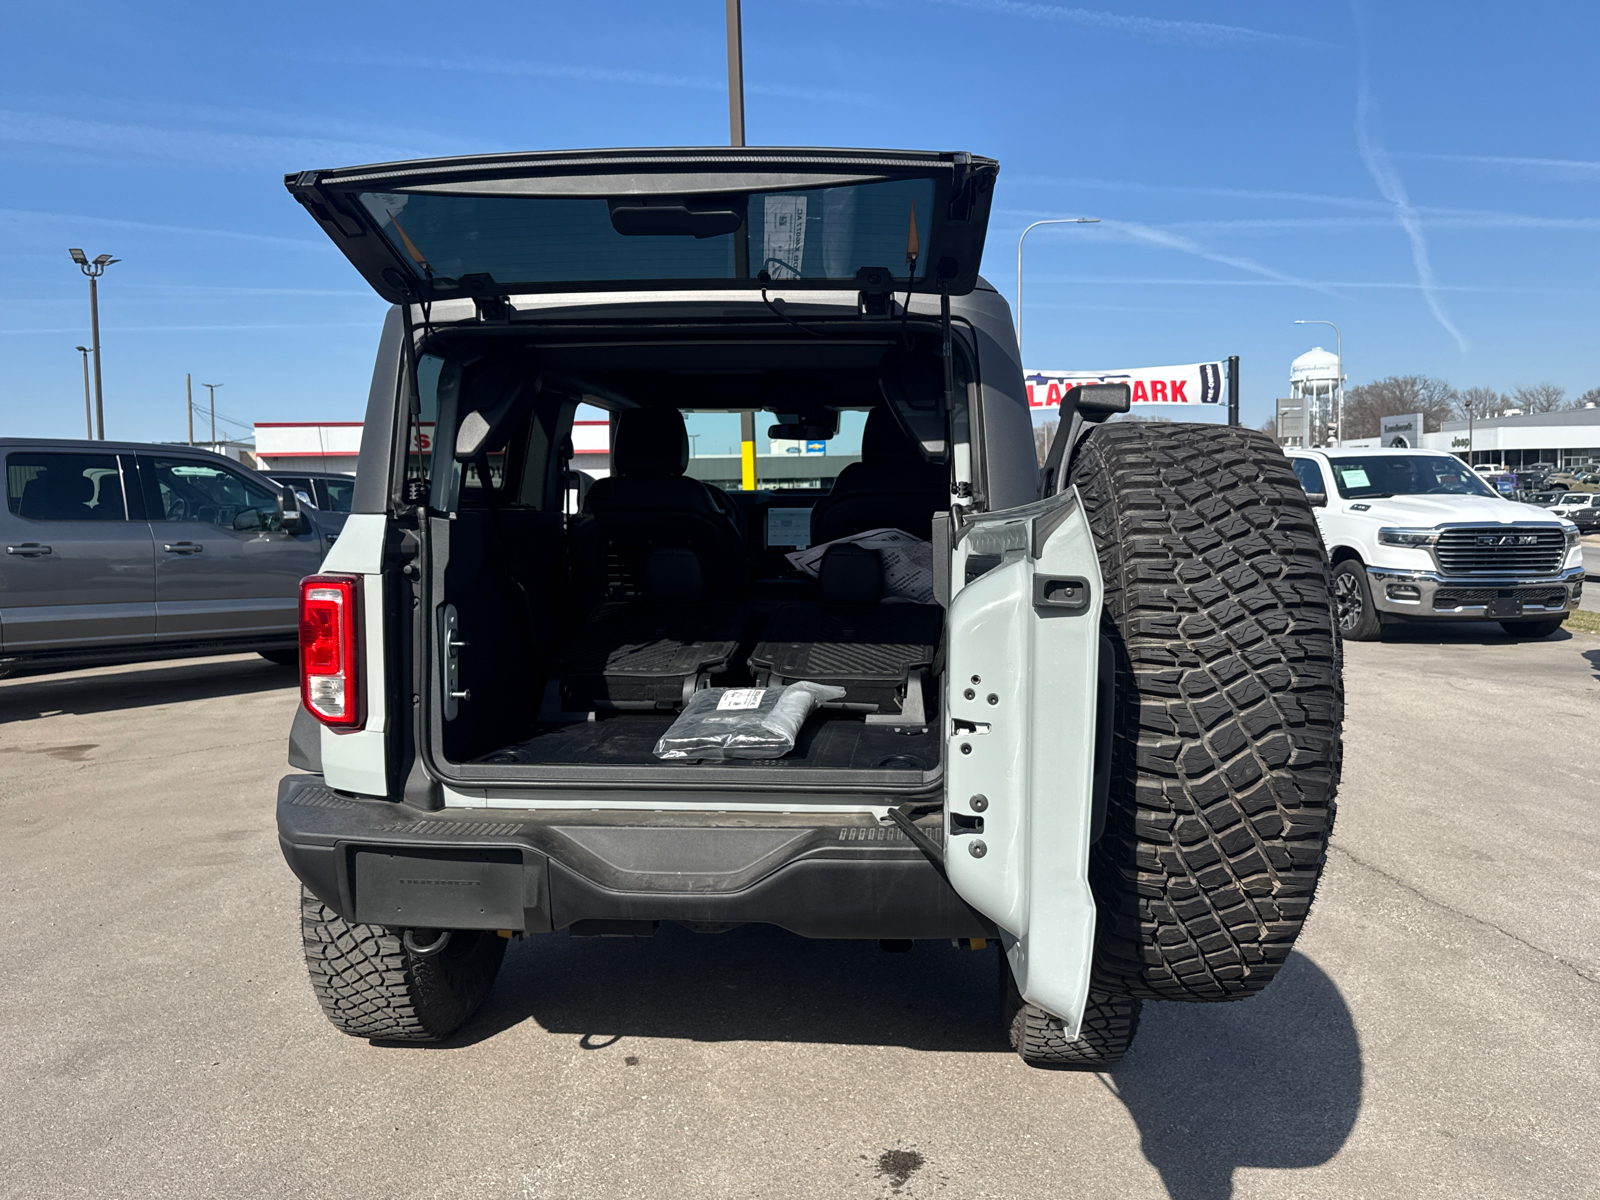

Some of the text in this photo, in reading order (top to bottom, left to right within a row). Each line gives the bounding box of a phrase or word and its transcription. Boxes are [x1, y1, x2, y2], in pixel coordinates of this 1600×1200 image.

[1026, 380, 1187, 407] LAARK
[1451, 436, 1469, 448] Jeep
[1477, 536, 1537, 545] RAM
